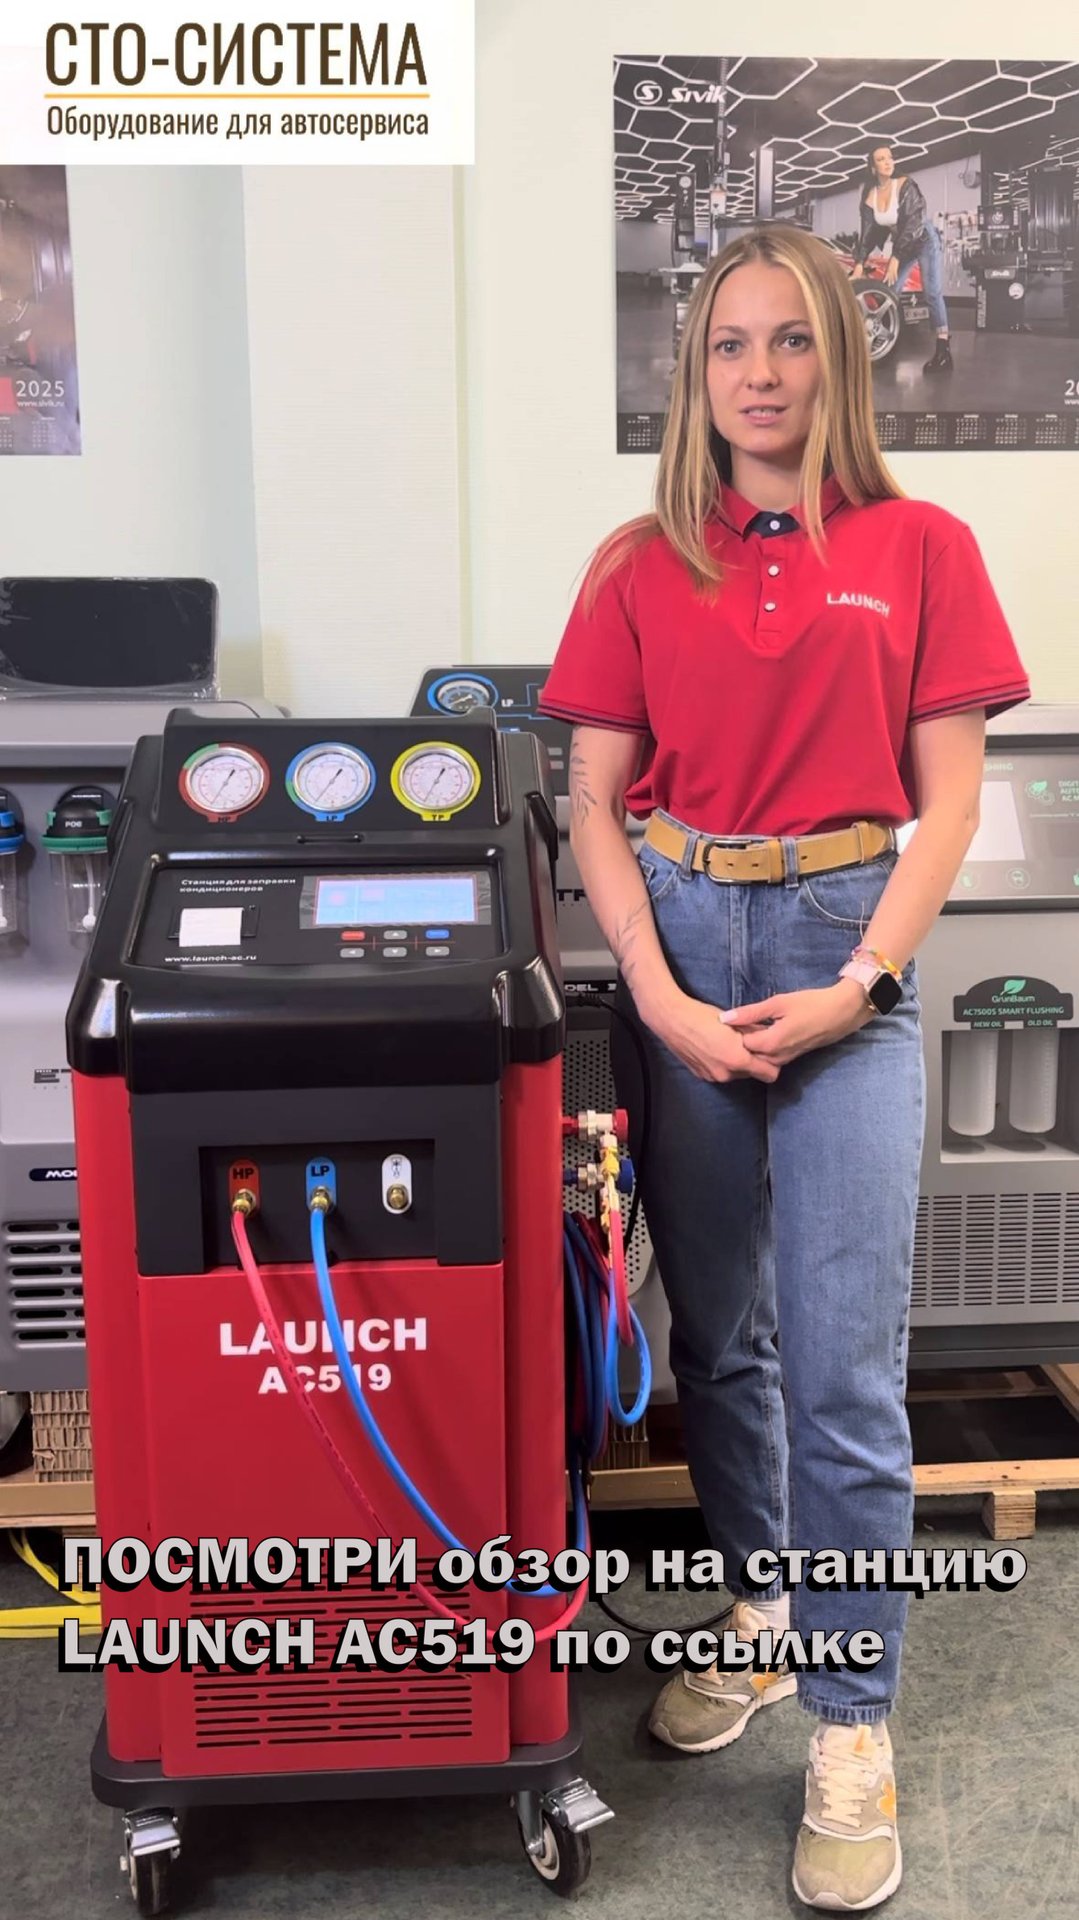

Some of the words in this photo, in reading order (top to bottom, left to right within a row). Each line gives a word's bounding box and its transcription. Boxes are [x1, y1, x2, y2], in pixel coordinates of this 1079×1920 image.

[15, 380, 65, 397] 2025
[826, 592, 891, 618] LAUNCH
[164, 955, 257, 963] www.launch-ac.ru
[998, 1006, 1024, 1015] SMART
[1026, 1005, 1065, 1014] FLUSHING
[232, 1167, 255, 1180] HP
[311, 1165, 330, 1177] LP
[220, 1317, 427, 1356] LAUNCH
